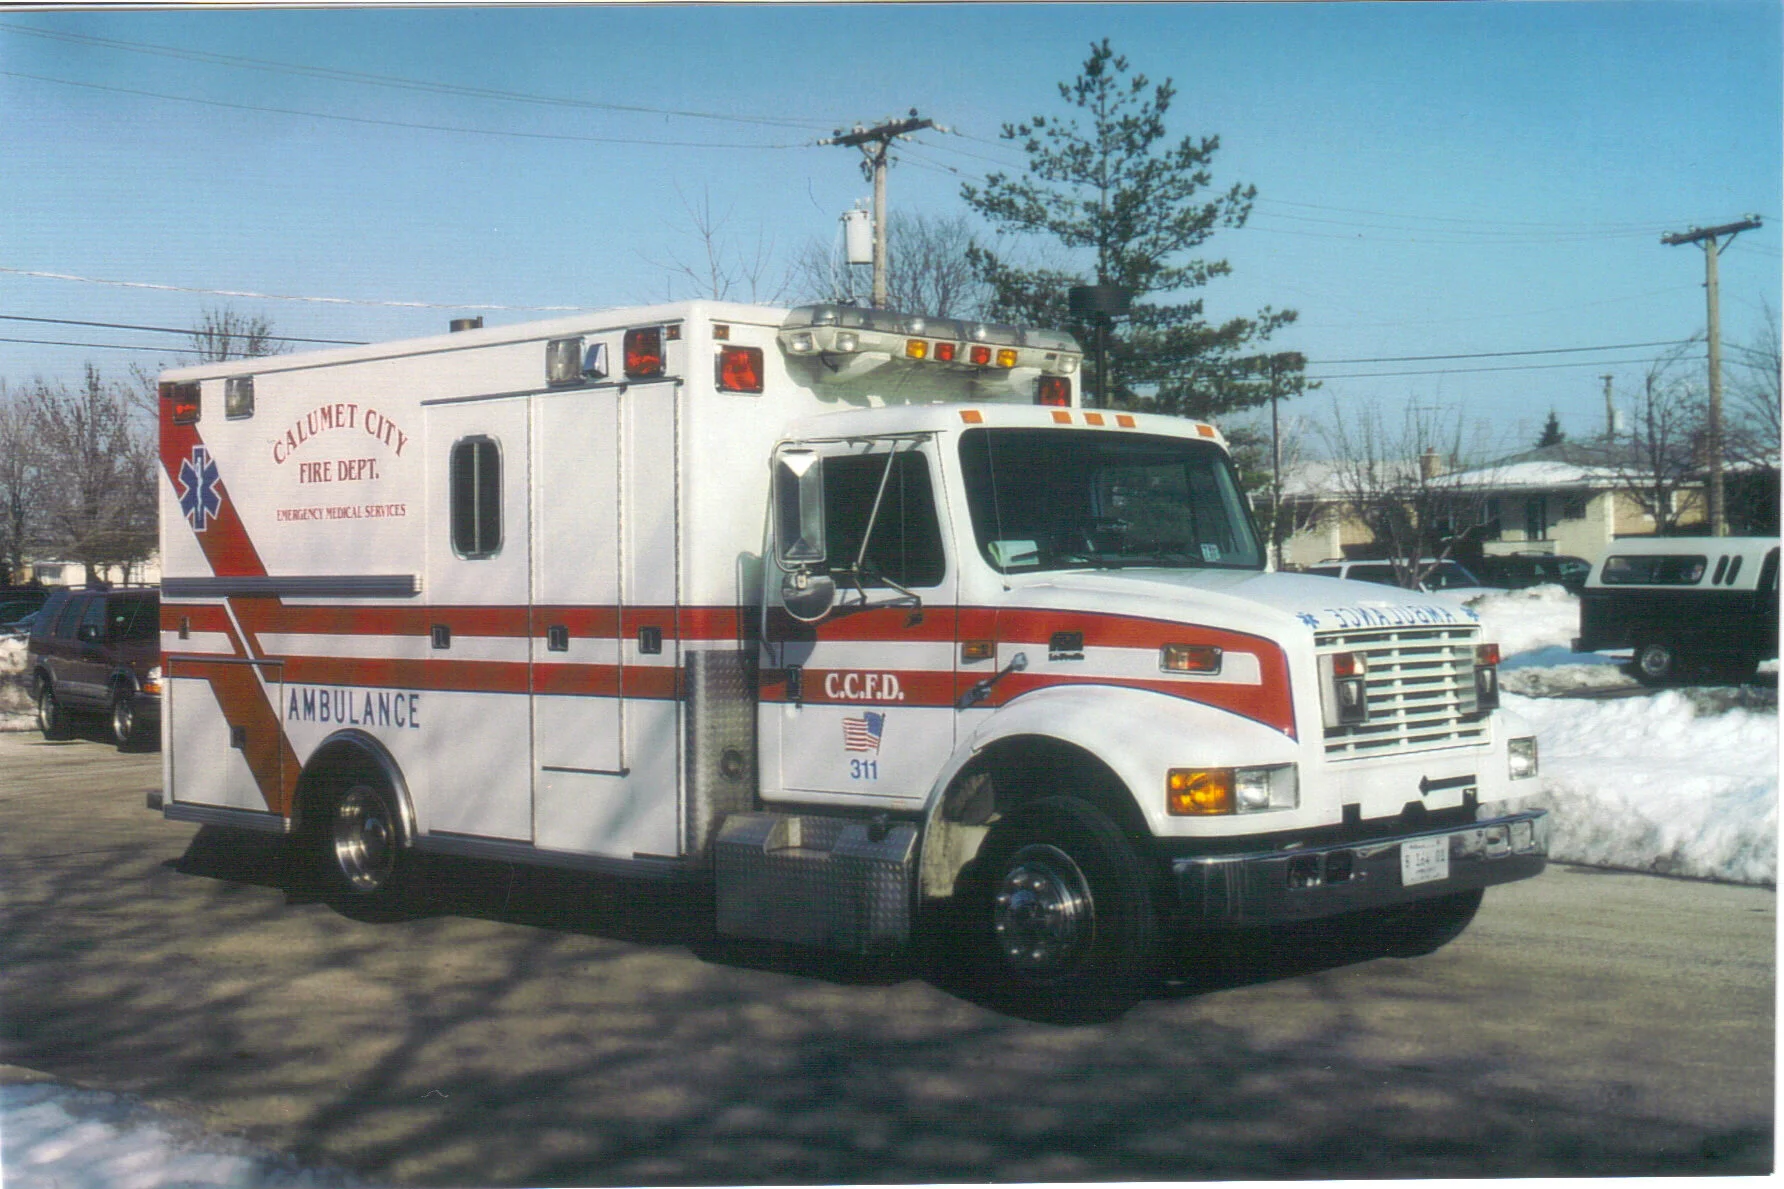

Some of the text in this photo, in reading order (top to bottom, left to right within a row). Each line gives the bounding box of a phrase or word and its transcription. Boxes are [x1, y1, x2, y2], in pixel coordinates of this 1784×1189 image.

[273, 403, 408, 464] CALUMET CITY
[299, 458, 380, 483] FIRE DEPT.
[277, 504, 406, 522] EMERGENCY MEDICAL SERVICES
[824, 672, 905, 700] C.C.F.D.
[288, 687, 420, 728] AMBULANCE
[849, 758, 877, 780] 311
